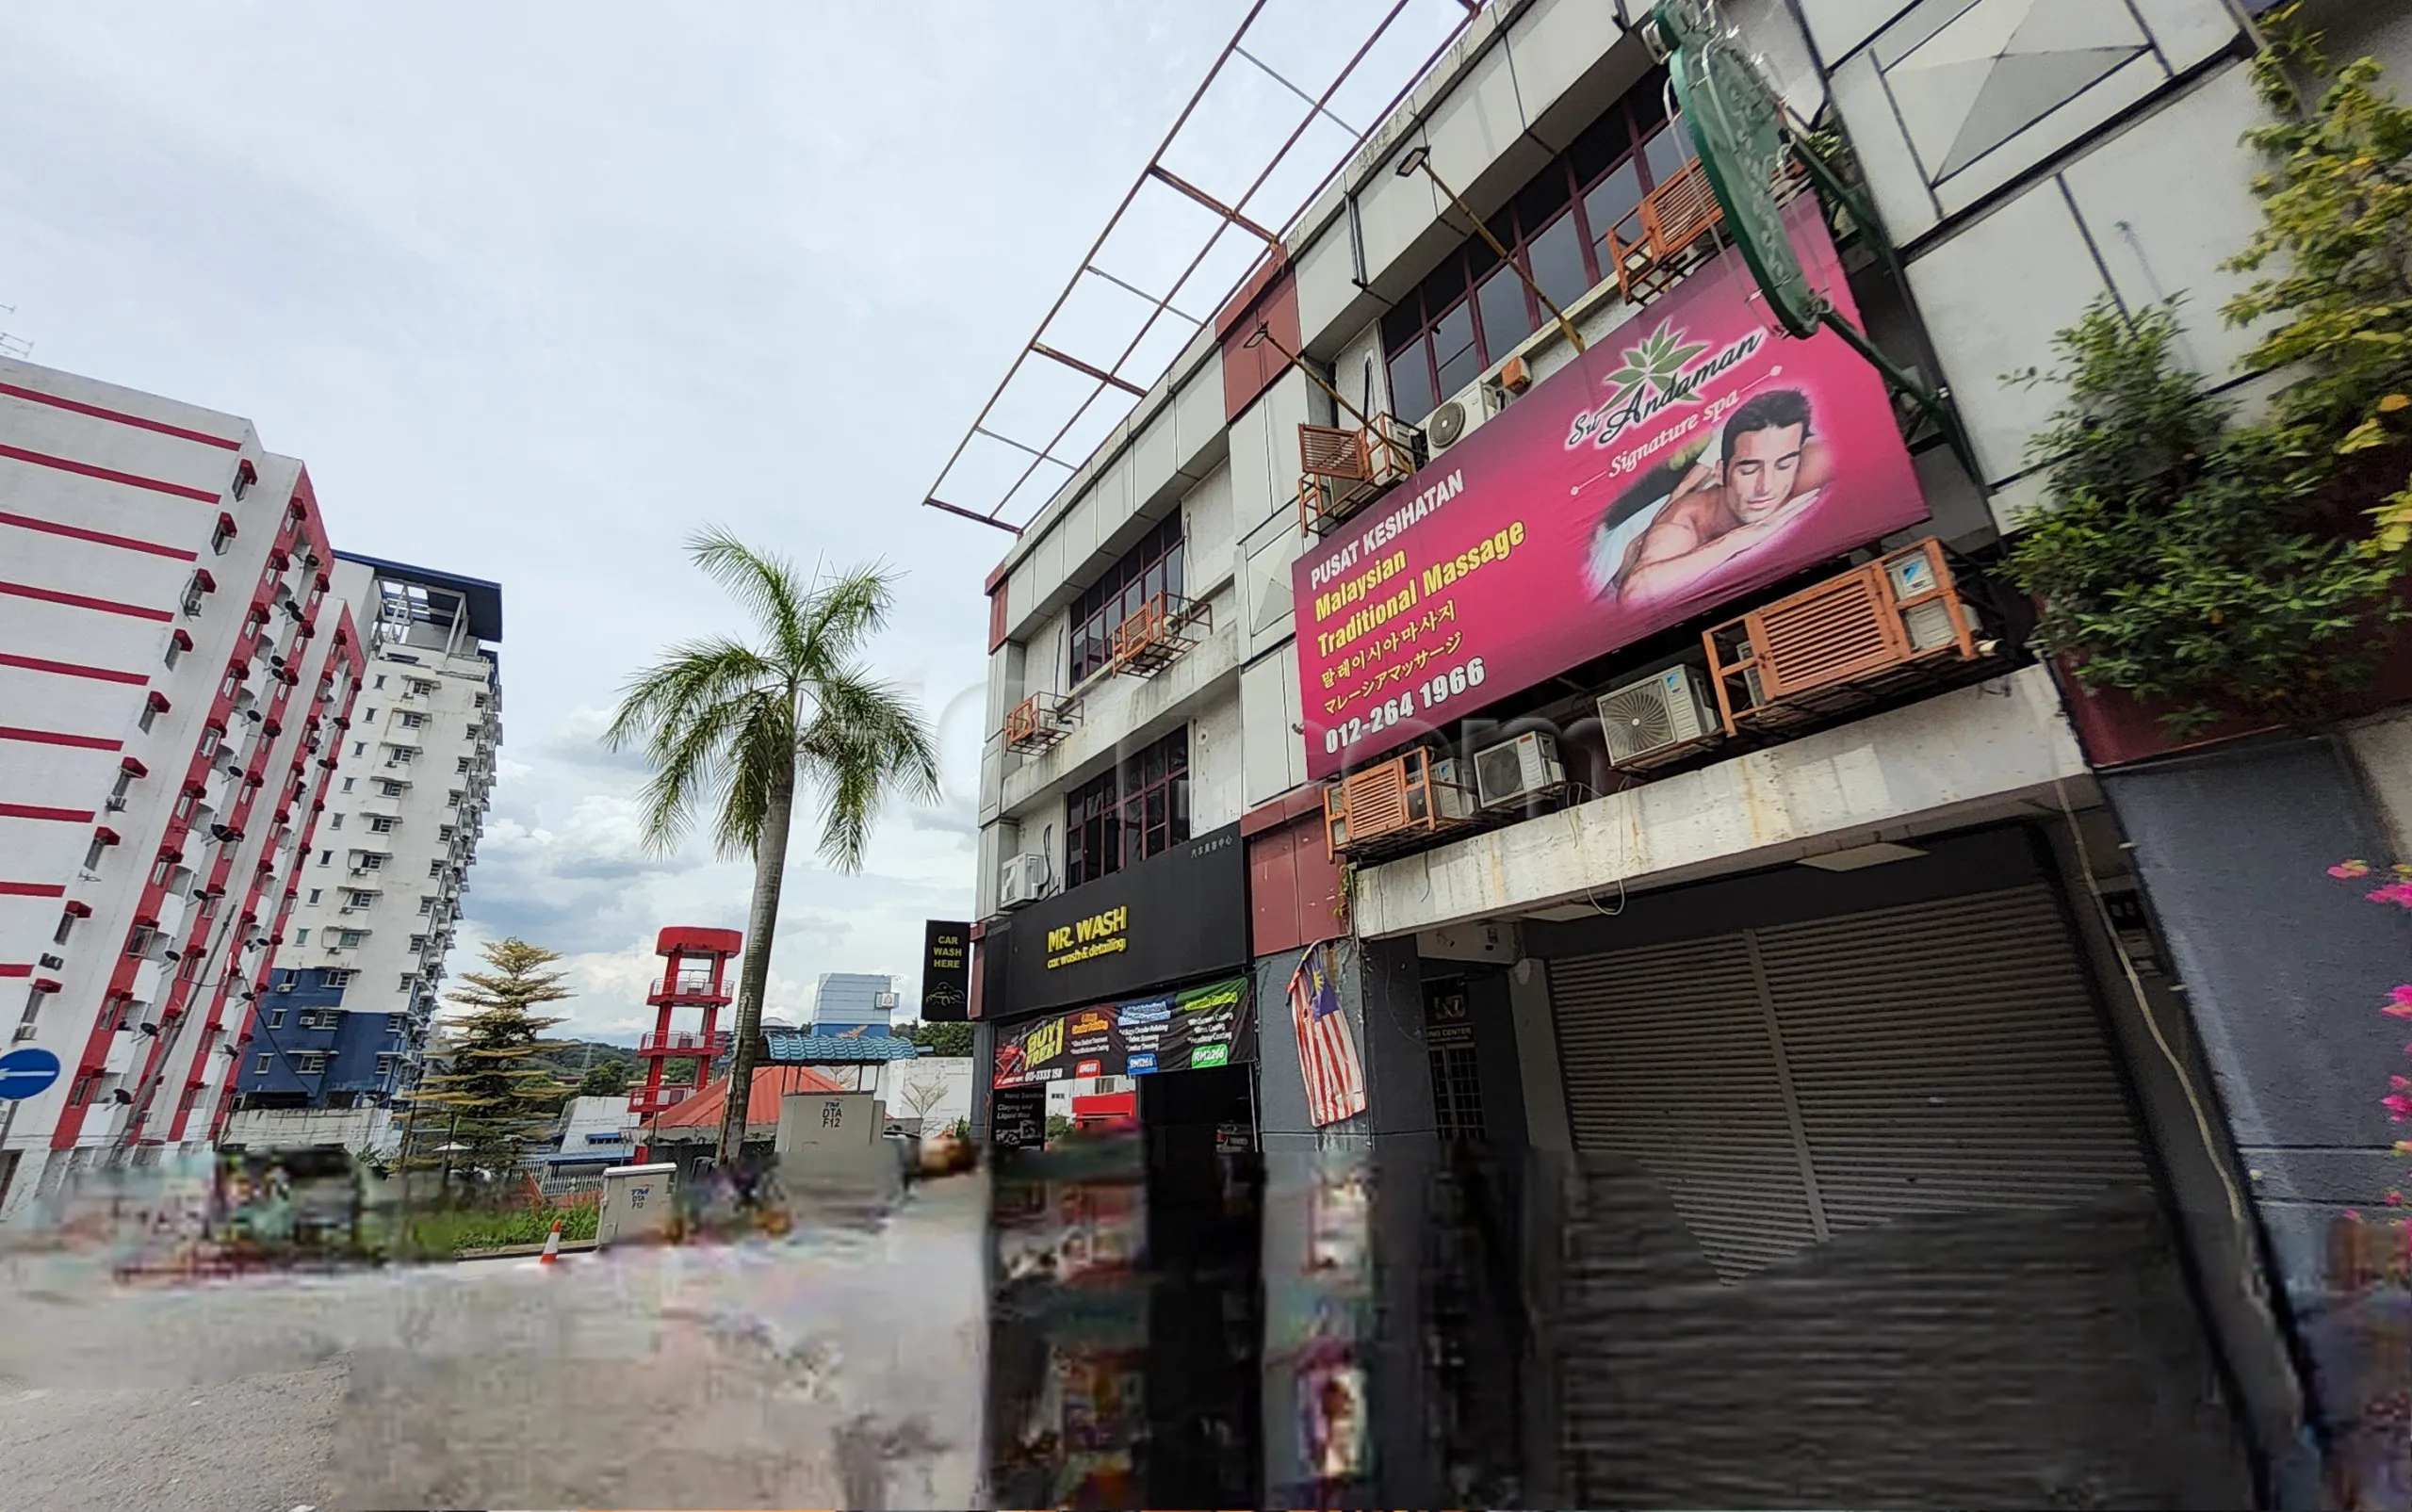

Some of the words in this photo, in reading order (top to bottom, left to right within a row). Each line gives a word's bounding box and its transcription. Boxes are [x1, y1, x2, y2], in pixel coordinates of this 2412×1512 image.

[1569, 415, 1601, 446] Sri
[1598, 334, 1763, 445] Andaman
[1608, 412, 1699, 478] Signature
[1703, 389, 1739, 426] spa
[1311, 540, 1359, 591] PUSAT
[1362, 468, 1464, 556] KESIHATAN
[1315, 549, 1407, 622] Malaysian
[1317, 577, 1418, 658] Traditional
[1422, 521, 1525, 597] Massage
[1324, 630, 1462, 715] マレーシアマッサージ
[1325, 691, 1415, 755] 012-264
[1418, 657, 1486, 709] 1966
[937, 935, 958, 945] CAR
[1048, 926, 1074, 952] MR.
[1076, 905, 1127, 943] WASH
[933, 947, 962, 957] WASH
[934, 959, 960, 968] HERE
[1048, 956, 1060, 968] car
[1089, 938, 1127, 957] detailing
[1024, 1041, 1056, 1071] FREE
[1027, 1021, 1056, 1055] BUY
[823, 1108, 842, 1118] DTA
[823, 1118, 841, 1128] F12
